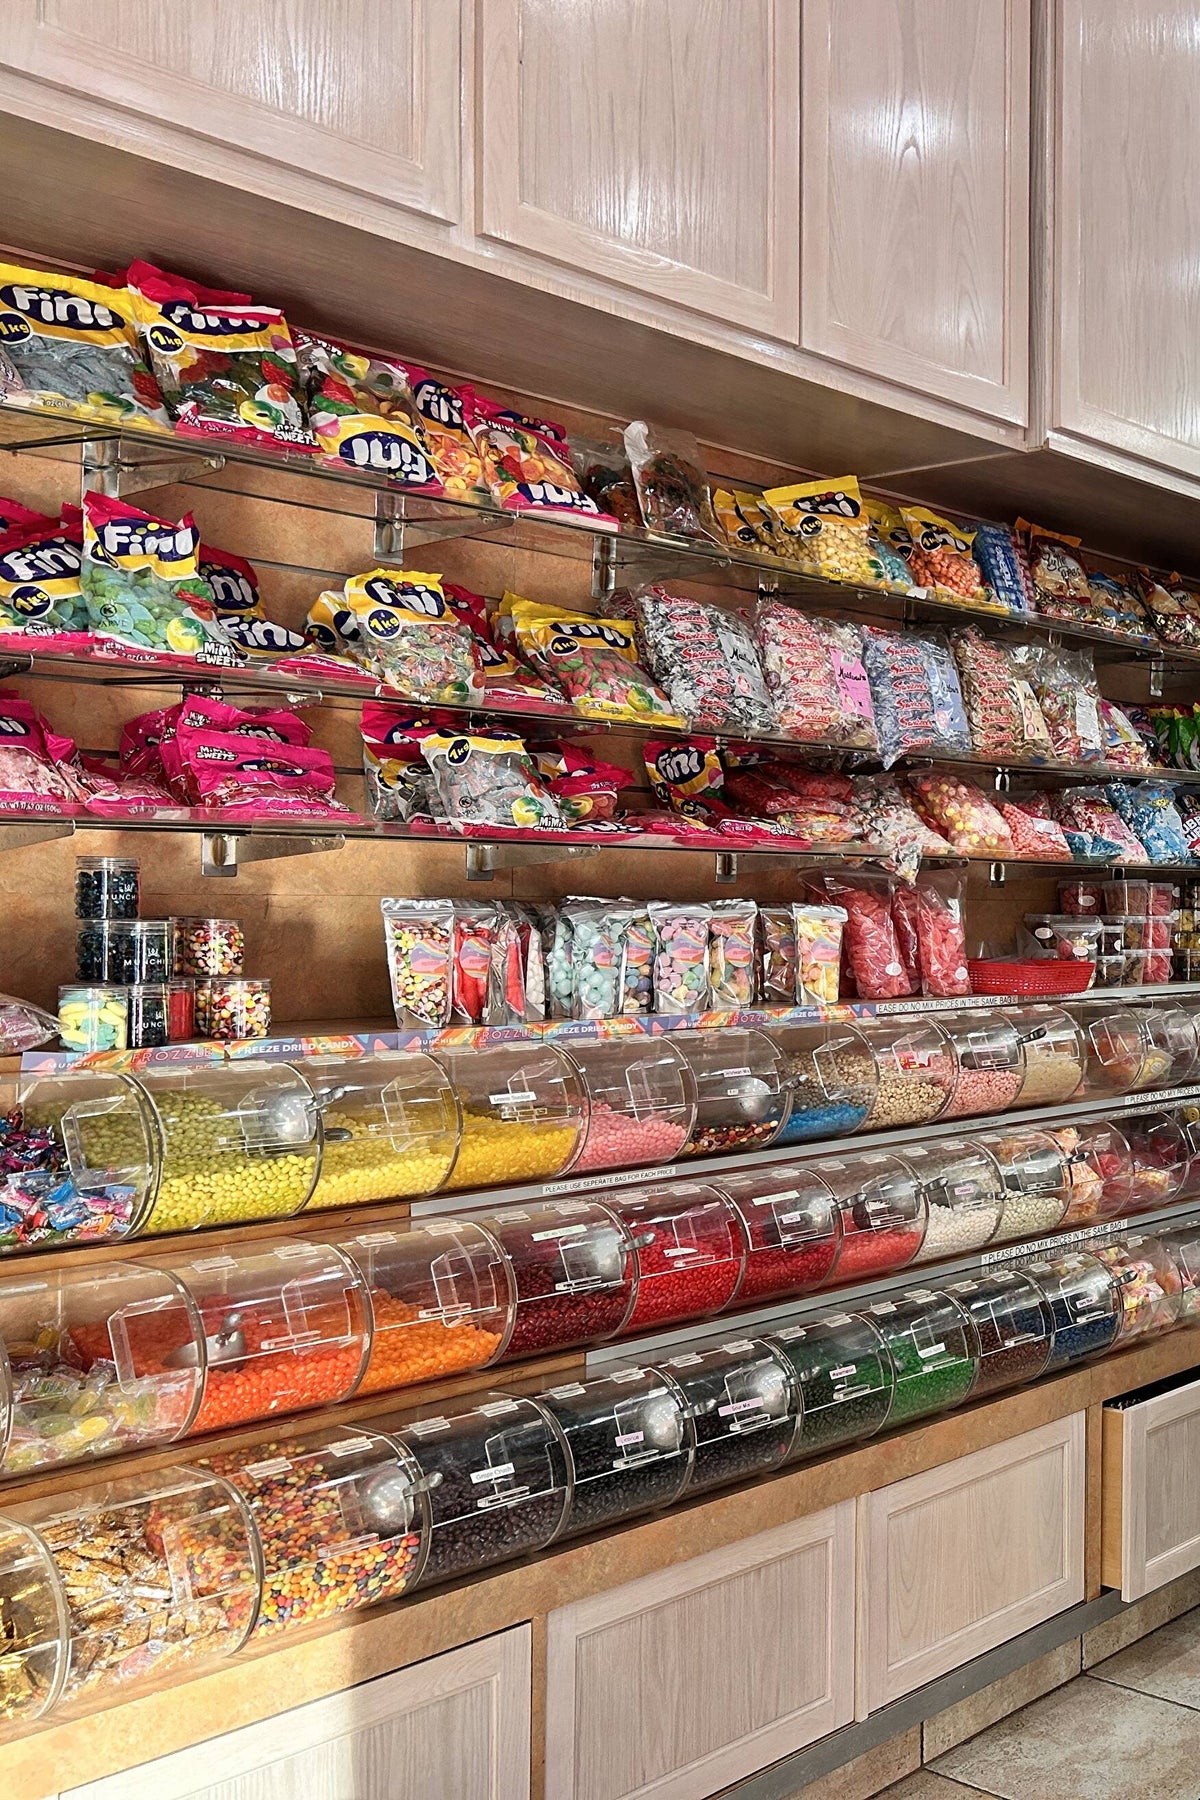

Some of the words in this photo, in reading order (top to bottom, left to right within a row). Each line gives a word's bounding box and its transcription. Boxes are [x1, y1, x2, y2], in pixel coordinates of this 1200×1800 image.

[13, 286, 114, 327] Fini
[151, 332, 183, 347] 1kg
[349, 436, 428, 482] Fini
[104, 523, 194, 556] Fini
[16, 589, 50, 611] 1kg
[202, 575, 254, 604] ini
[220, 613, 305, 648] Fini
[369, 614, 399, 633] 1kg
[197, 651, 246, 668] SWEETS
[448, 741, 471, 763] 1kg
[656, 748, 700, 777] Fini
[921, 1001, 934, 1011] MIX
[936, 999, 958, 1010] PRICES
[967, 998, 979, 1007] THE
[980, 997, 998, 1006] SAME
[608, 1022, 638, 1033] CANDY
[318, 1039, 357, 1052] CANDY
[545, 1179, 569, 1193] PLEASE
[569, 1179, 581, 1190] USE
[583, 1175, 614, 1189] SEPERATE
[614, 1174, 626, 1184] BAG
[628, 1173, 640, 1182] FOR
[640, 1170, 655, 1180] EACH
[656, 1167, 674, 1178] PRICE
[989, 1250, 1013, 1263] PLEASE
[1015, 1246, 1025, 1255] DO
[1026, 1243, 1036, 1252] NO
[1037, 1240, 1048, 1250] MIX
[1050, 1234, 1072, 1247] PRICES
[1073, 1231, 1079, 1240] IN
[1080, 1229, 1092, 1238] THE
[1093, 1223, 1109, 1235] SAME
[1110, 1221, 1122, 1232] BAG
